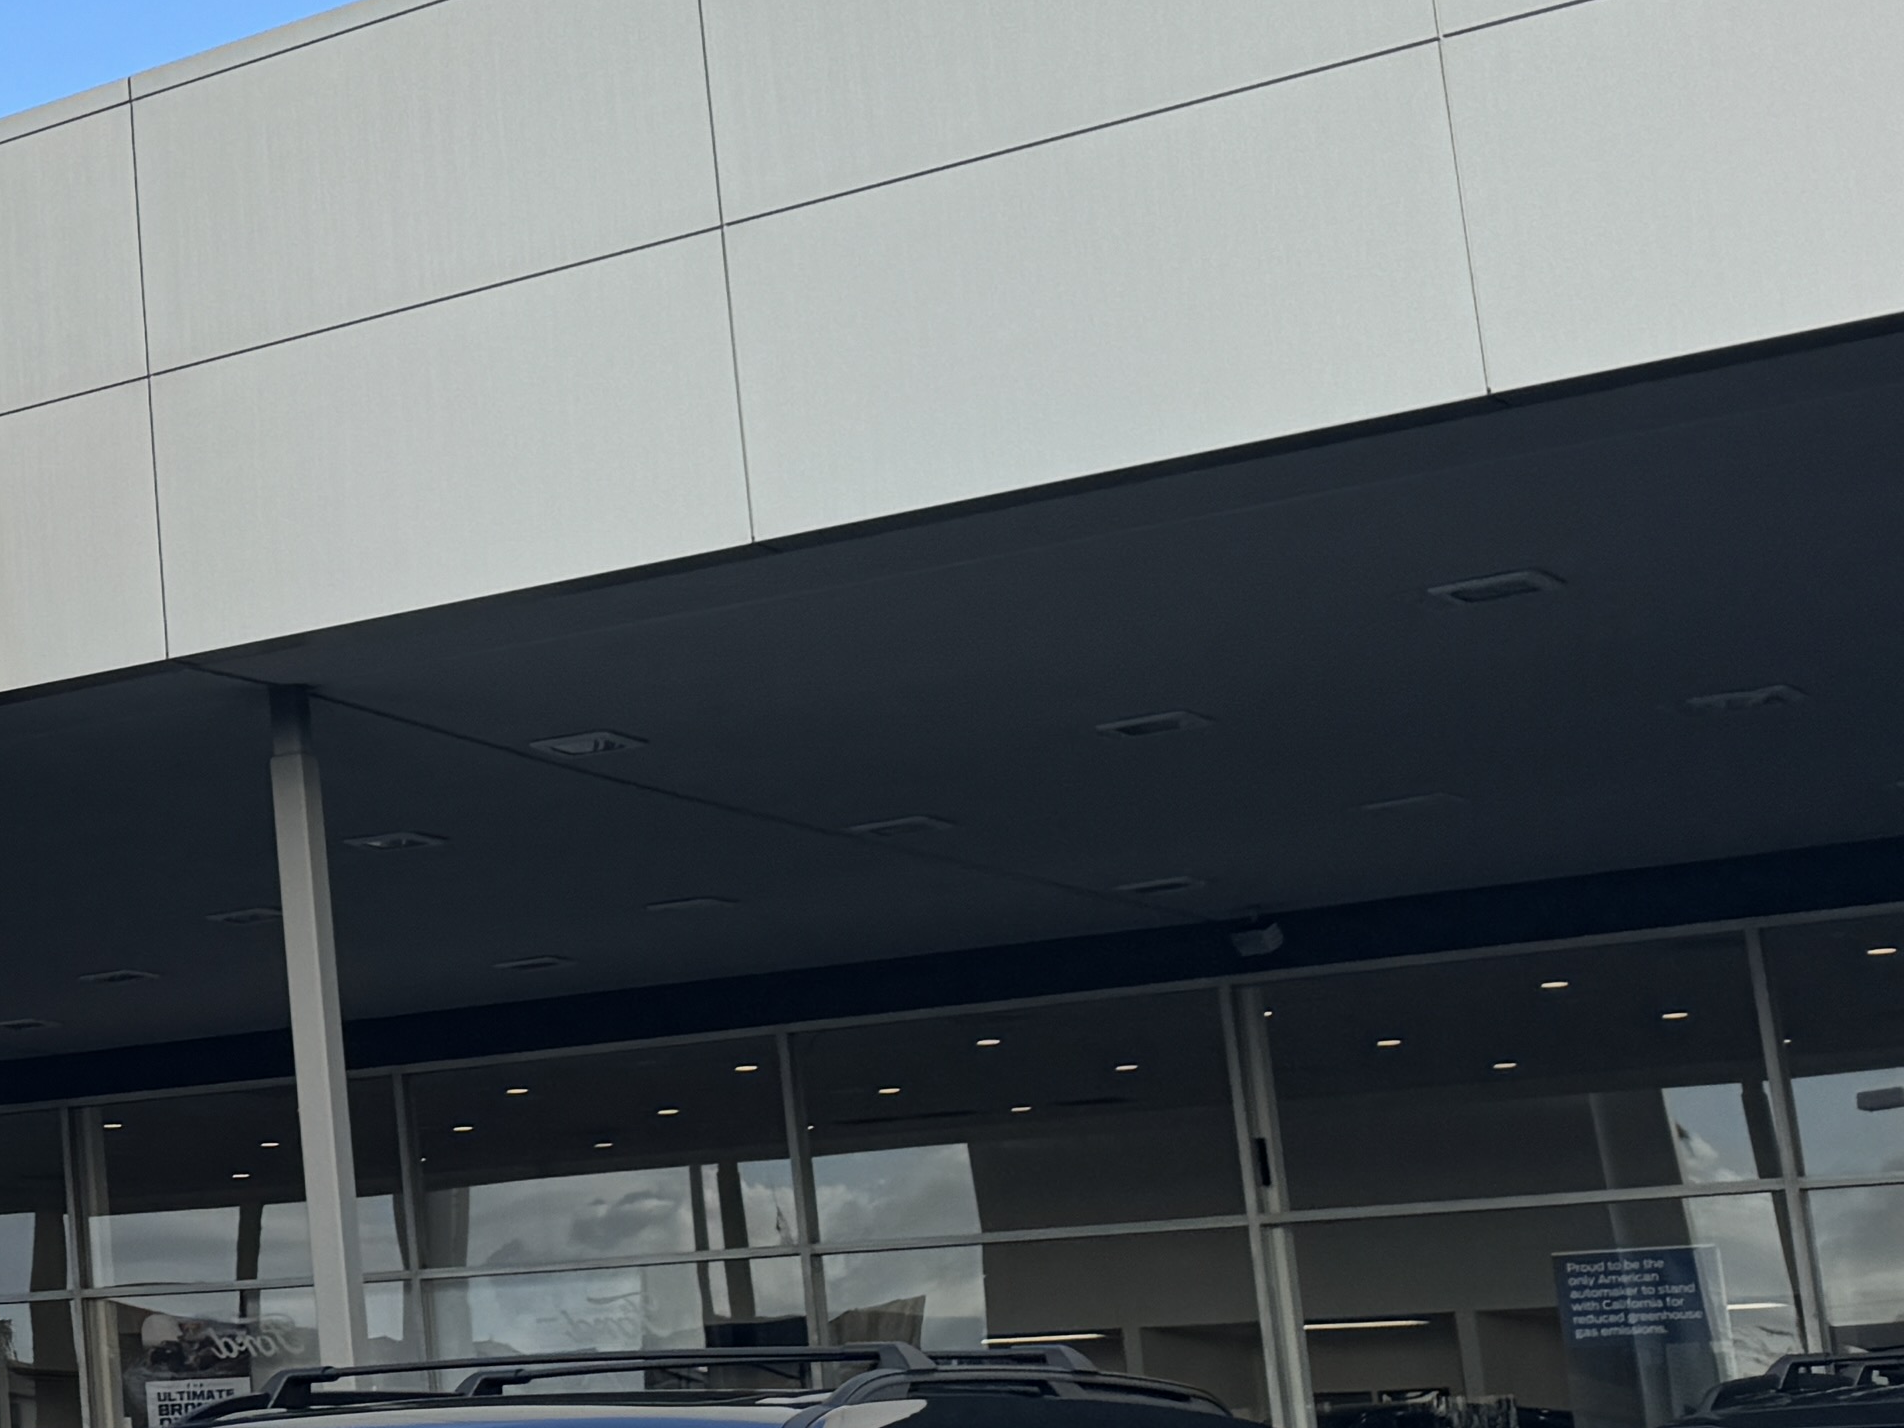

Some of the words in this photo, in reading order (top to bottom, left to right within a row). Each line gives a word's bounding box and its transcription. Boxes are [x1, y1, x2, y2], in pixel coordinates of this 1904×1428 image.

[1566, 1262, 1605, 1273] Proud
[1607, 1260, 1622, 1271] to
[1623, 1259, 1640, 1270] be
[1643, 1258, 1664, 1269] the
[1568, 1275, 1595, 1287] only
[1597, 1272, 1659, 1284] American
[1569, 1285, 1638, 1299] automaker
[1641, 1284, 1655, 1295] to
[1658, 1283, 1695, 1294] stand
[1571, 1300, 1600, 1312] with
[1602, 1298, 1663, 1310] California
[1666, 1296, 1685, 1307] for
[1572, 1312, 1625, 1325] reduced
[1627, 1309, 1703, 1324] greenhouse
[1575, 1328, 1599, 1340] gas
[1600, 1323, 1669, 1337] emissions.
[157, 1388, 234, 1402] ULTIMATE
